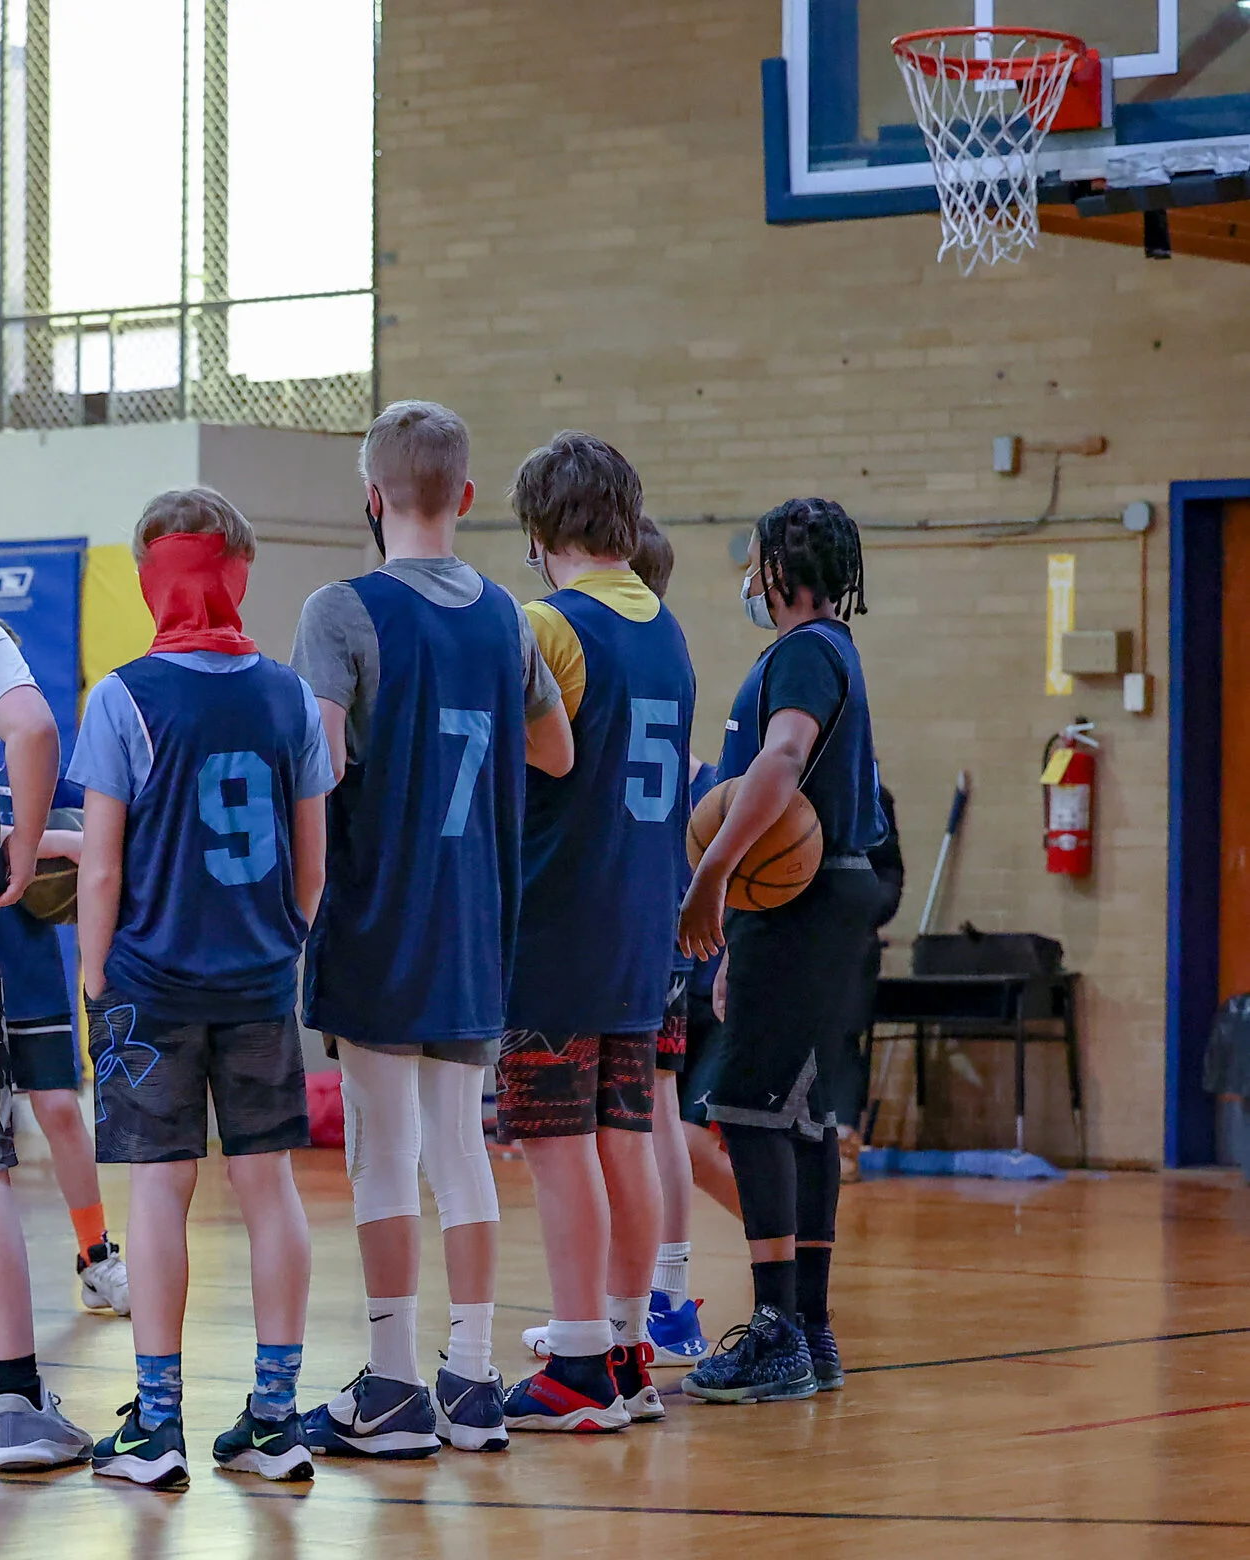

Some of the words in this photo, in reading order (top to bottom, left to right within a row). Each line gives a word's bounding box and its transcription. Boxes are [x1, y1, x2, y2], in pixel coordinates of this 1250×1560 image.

[198, 751, 277, 885] 9
[440, 708, 491, 836] 7
[624, 698, 679, 821] 5
